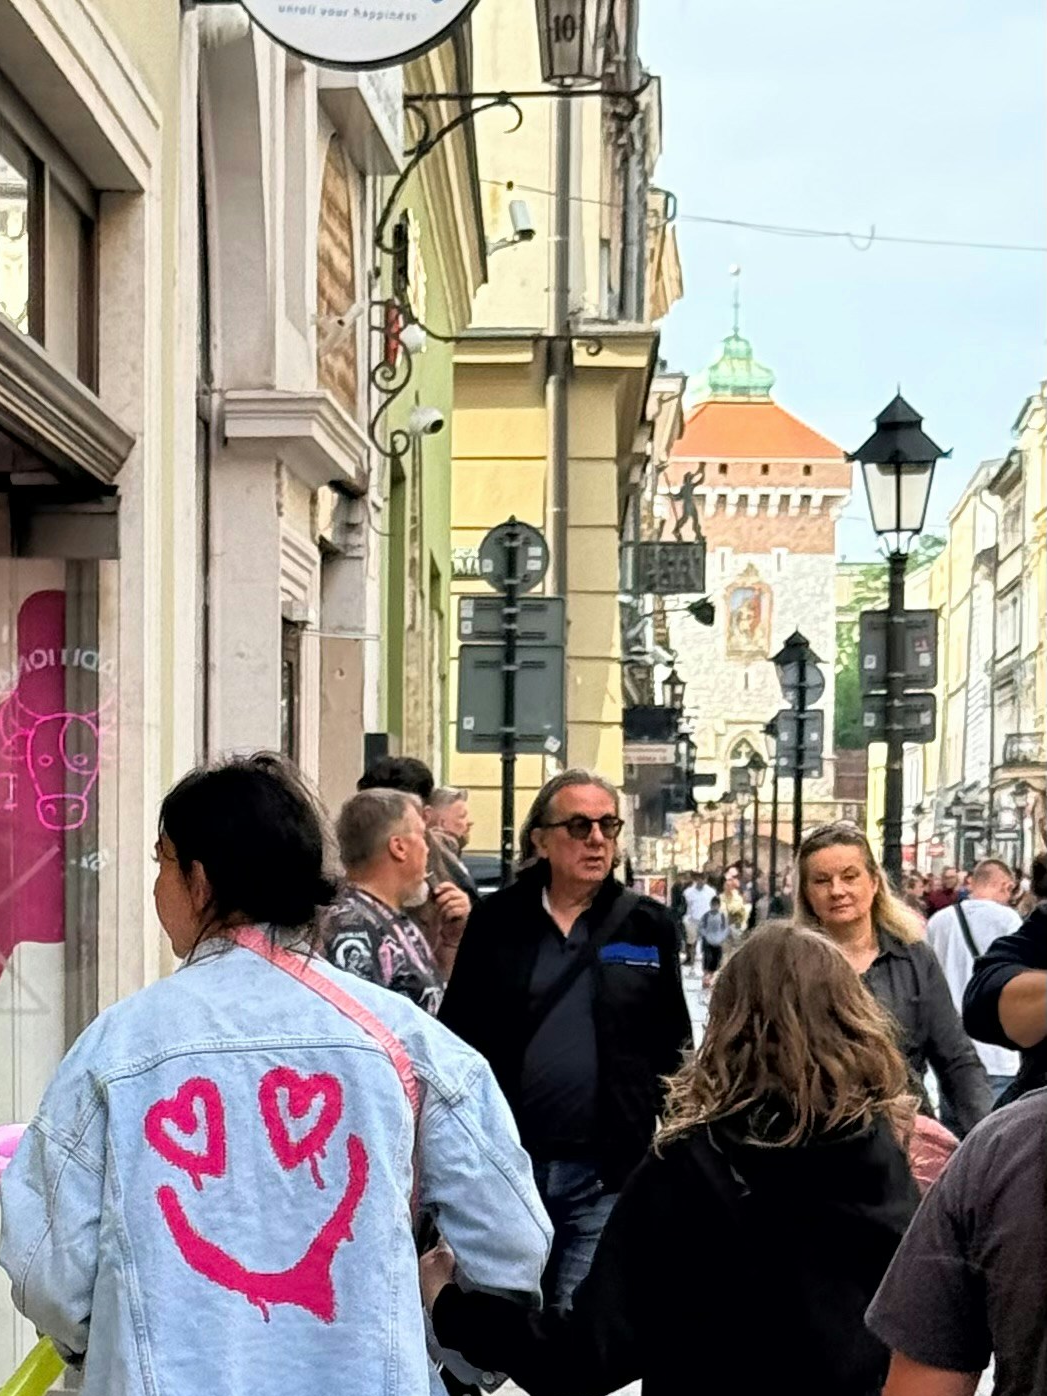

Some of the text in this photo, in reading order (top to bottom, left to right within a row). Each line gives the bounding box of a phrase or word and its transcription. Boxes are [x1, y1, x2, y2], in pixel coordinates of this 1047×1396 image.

[278, 4, 418, 22] unroll your happiness
[554, 14, 575, 42] 10
